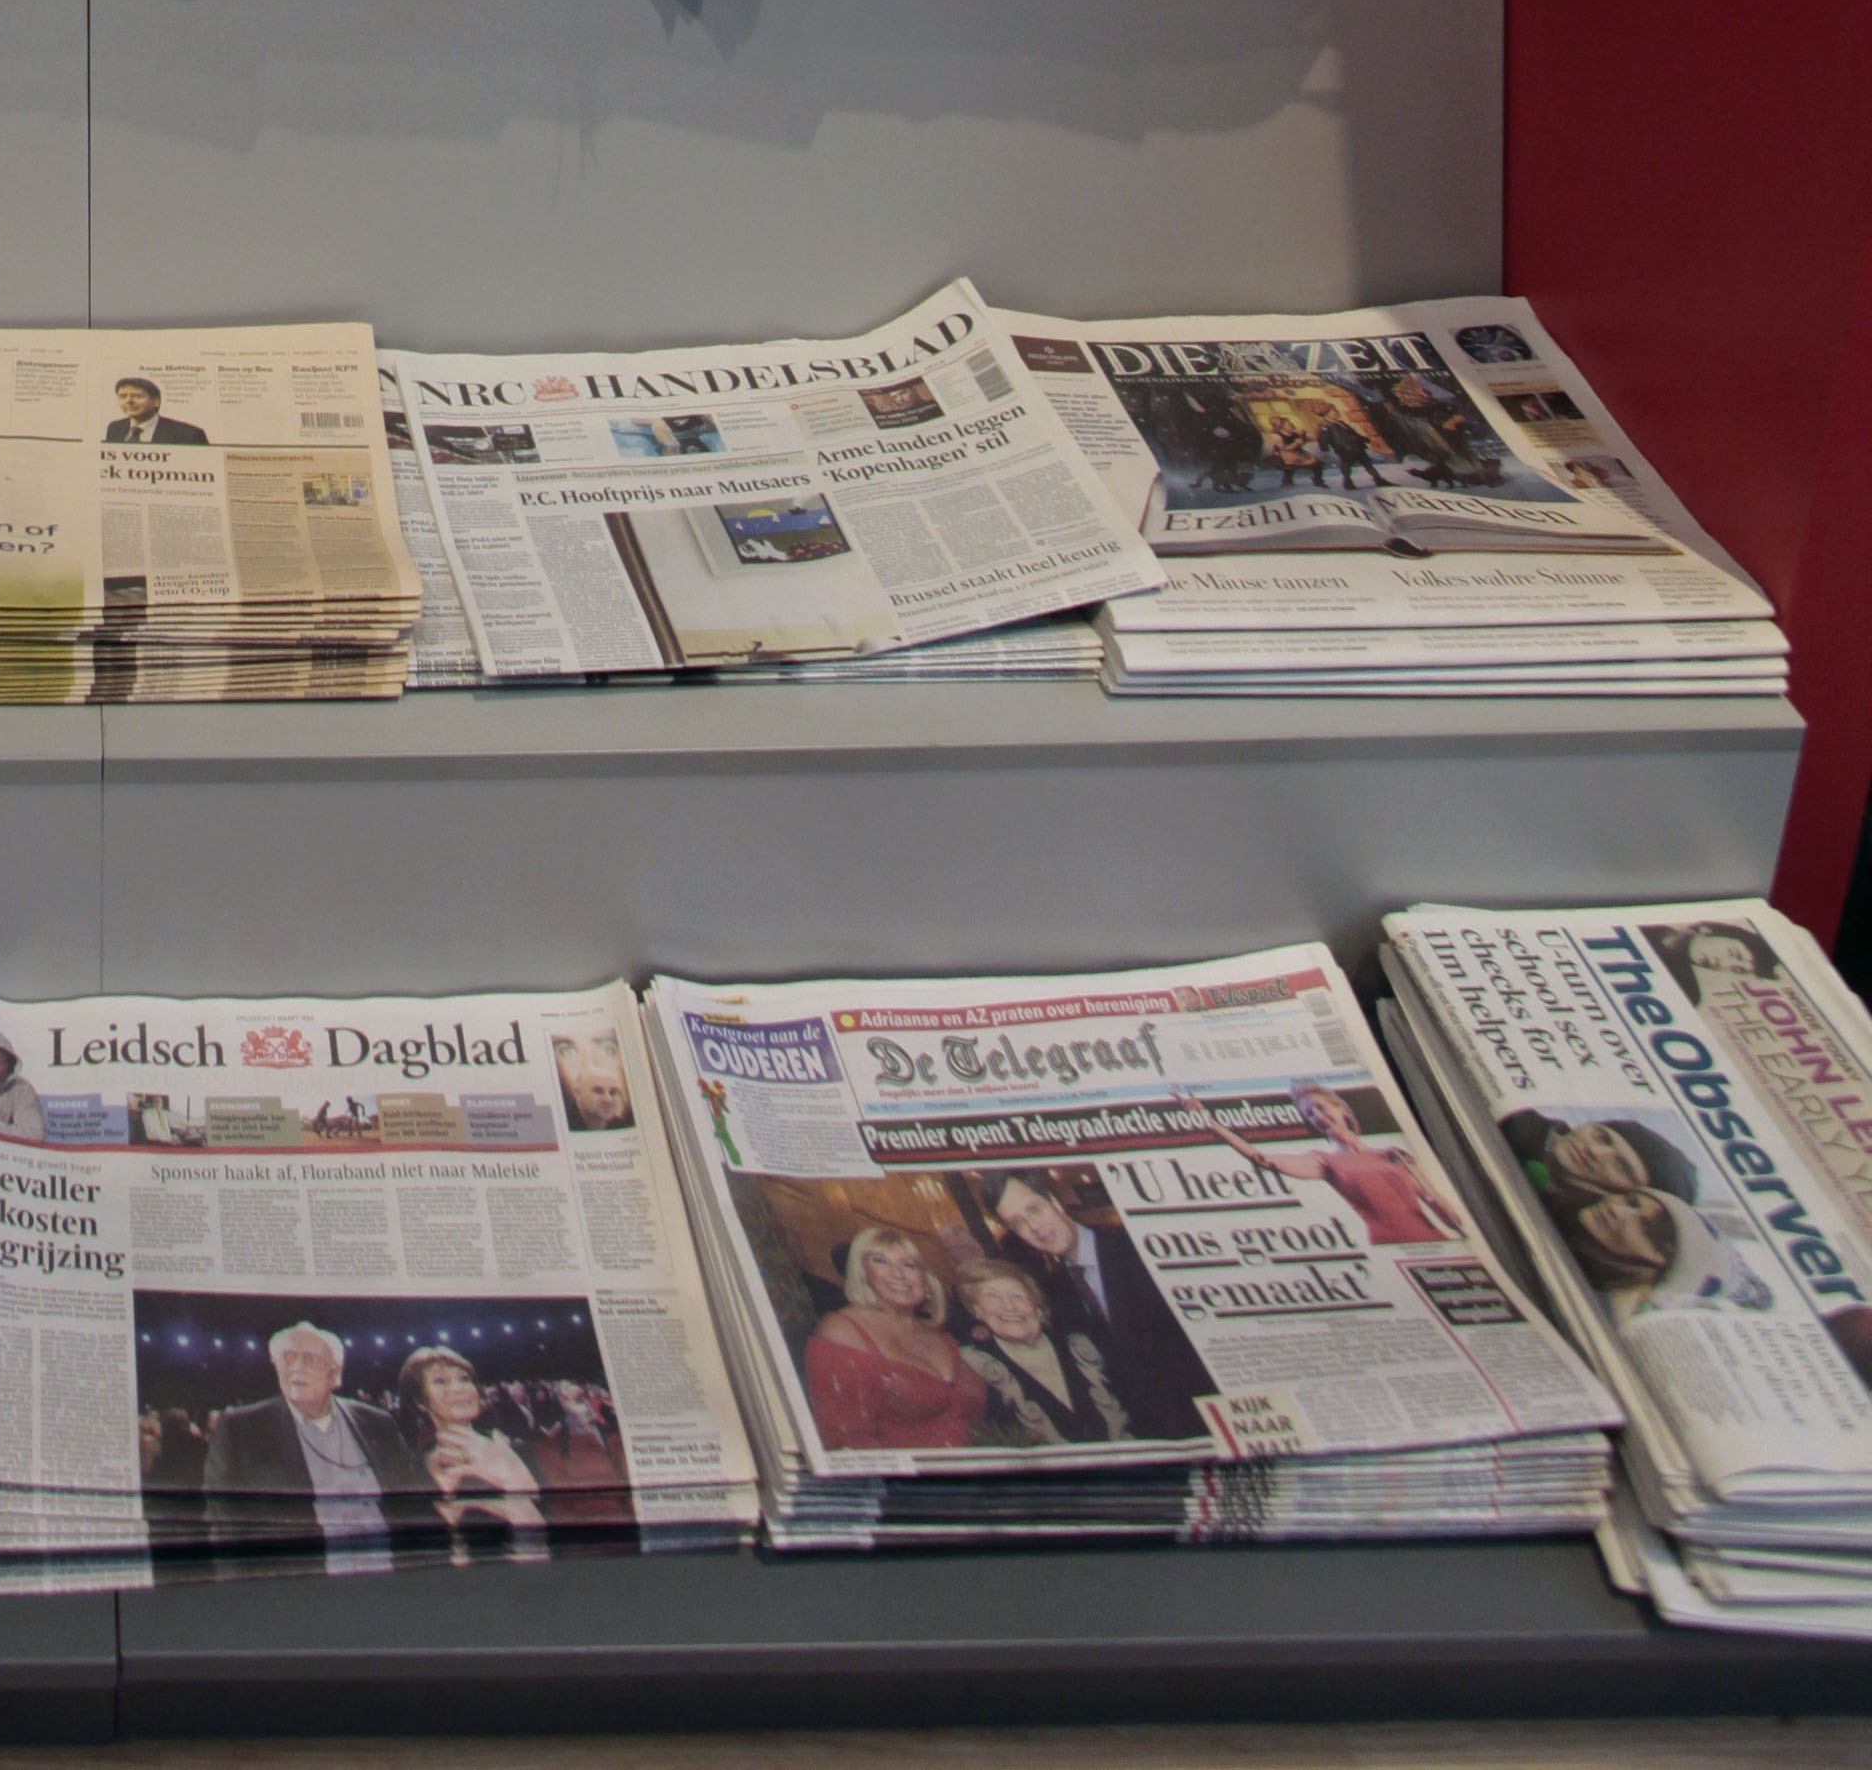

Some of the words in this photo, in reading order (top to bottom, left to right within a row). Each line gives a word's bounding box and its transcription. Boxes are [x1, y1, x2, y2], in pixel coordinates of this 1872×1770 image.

[415, 379, 527, 408] NRC
[579, 311, 976, 401] HANDELSBLAD
[1107, 344, 1221, 377] DIE
[1290, 336, 1444, 373] ZEIT
[816, 443, 871, 466] Arme
[871, 422, 942, 456] landen
[946, 405, 1027, 440] leggen
[822, 444, 968, 486] ‘Kopenhagen’
[973, 429, 1010, 455] stil
[520, 491, 557, 508] P.C.
[560, 481, 666, 509] Hooftprijs
[670, 482, 709, 499] naar
[714, 472, 810, 496] Mutsaers
[1162, 503, 1302, 534] Erzähl
[1307, 502, 1375, 525] mir
[1375, 490, 1579, 528] Märchen
[24, 522, 58, 537] of
[1424, 930, 1468, 979] 11m
[1458, 983, 1536, 1091] helpers
[1461, 929, 1531, 1022] checks
[1529, 1026, 1563, 1071] for
[1497, 927, 1573, 1016] school
[1561, 1021, 1600, 1068] sex
[1536, 930, 1606, 1023] U-turn
[1601, 1028, 1657, 1096] over
[47, 1025, 225, 1071] Leidsch
[325, 1021, 529, 1078] Dagblad
[867, 1035, 940, 1086] De
[944, 1022, 1169, 1083] Telegraaf
[864, 1125, 944, 1152] Premier
[951, 1119, 1011, 1148] opent
[1016, 1107, 1163, 1148] Telegraafactie
[1166, 1107, 1212, 1134] voor
[1216, 1099, 1302, 1130] ouderen
[151, 1164, 219, 1182] Sponsor
[223, 1162, 272, 1181] haakt
[277, 1162, 298, 1182] af,
[301, 1161, 385, 1181] Floraband
[391, 1161, 423, 1179] niet
[427, 1164, 466, 1179] naar
[471, 1160, 540, 1178] Maleisië
[1144, 1230, 1230, 1259] ons
[1237, 1216, 1358, 1263] groot
[1173, 1265, 1370, 1318] gemaakt’
